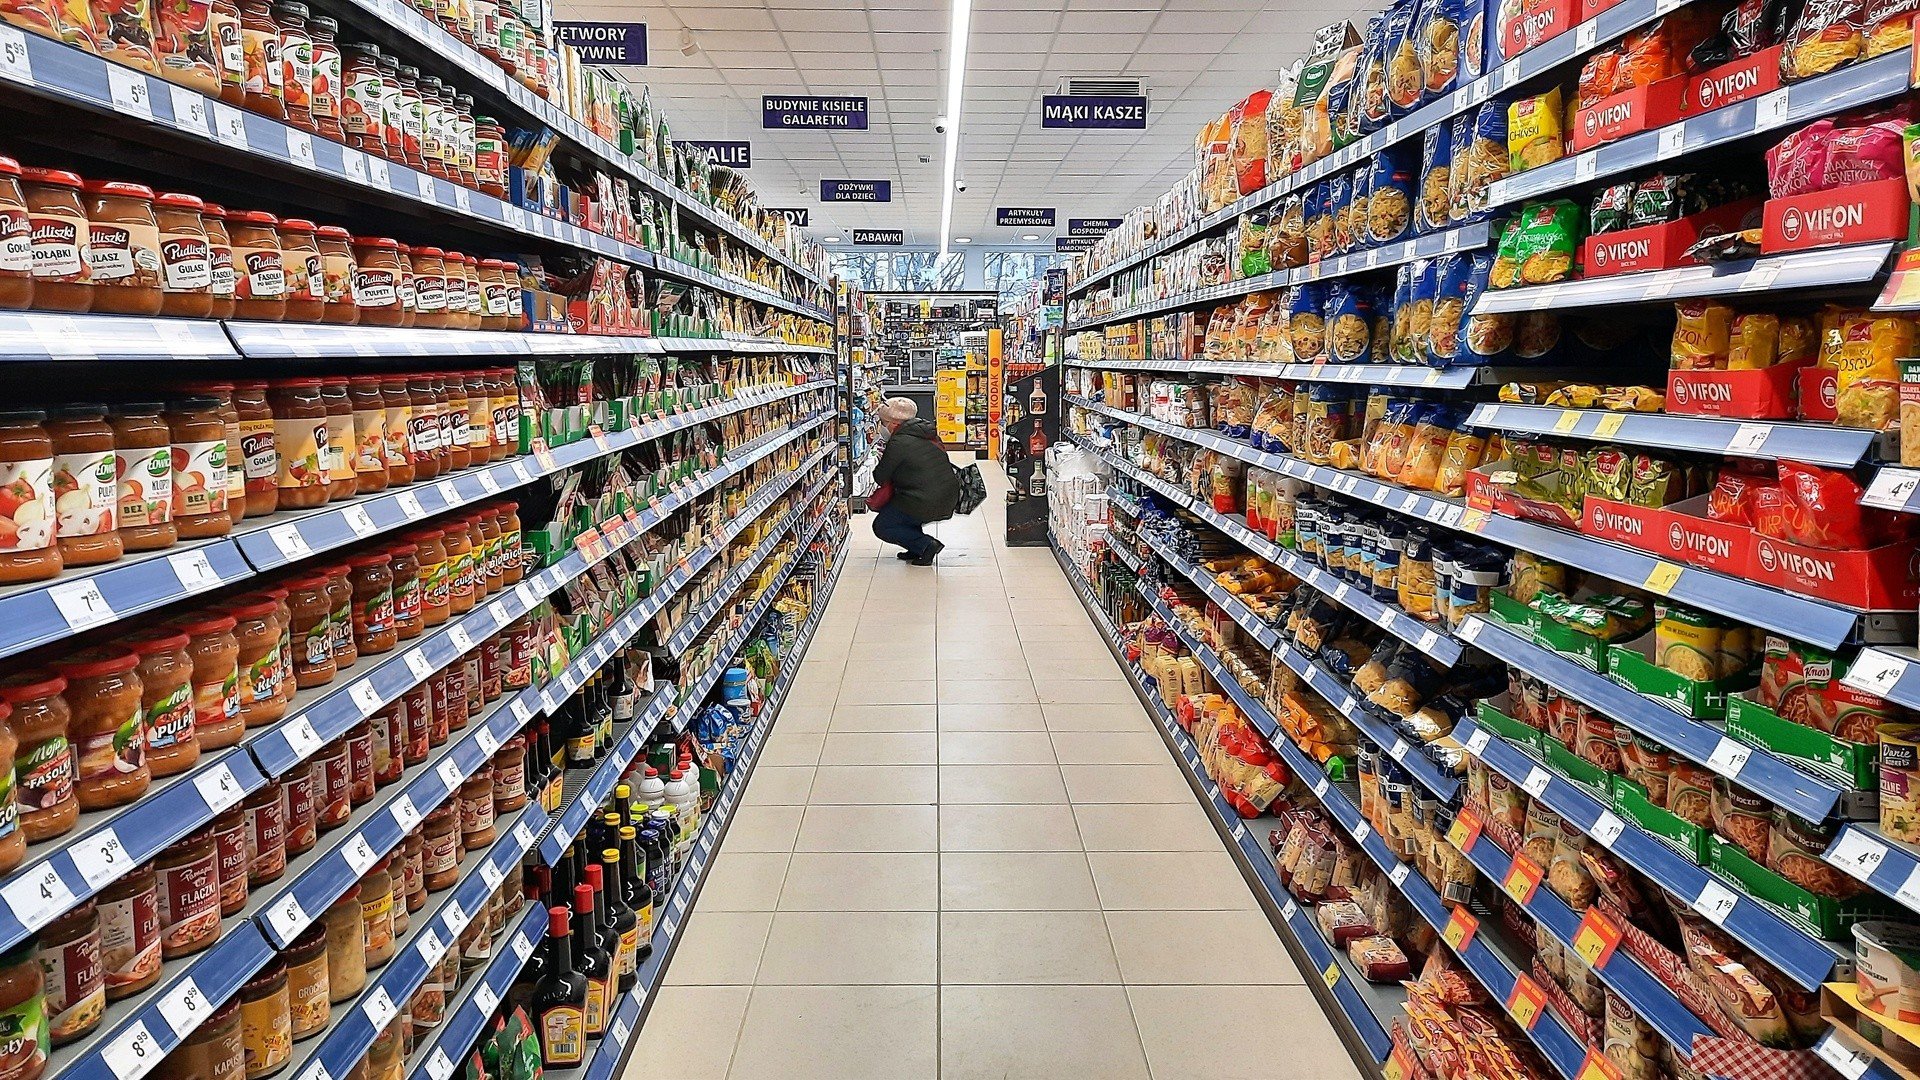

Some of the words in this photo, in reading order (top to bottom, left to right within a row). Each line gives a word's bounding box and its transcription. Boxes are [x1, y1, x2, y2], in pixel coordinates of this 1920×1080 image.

[573, 46, 626, 60] YWNE
[1715, 67, 1758, 97] VIFON
[766, 100, 819, 111] BUDYNIE
[822, 100, 864, 112] KISIELE
[1045, 105, 1089, 122] MĄKI
[1093, 106, 1143, 120] KASZE
[1598, 101, 1632, 127] VIFON
[782, 114, 848, 126] GALARETKI
[835, 192, 850, 200] DLA
[838, 183, 874, 191] ODŻYWKI
[1804, 202, 1863, 232] VIFON
[855, 232, 902, 243] ZABAWKI
[1607, 240, 1649, 261] VIFON
[178, 263, 205, 274] GULASZ
[364, 288, 389, 297] PULPETY
[990, 373, 999, 408] KODAK
[1687, 382, 1732, 402] VIFON
[1891, 480, 1915, 497] 449
[124, 504, 142, 514] BEZ
[187, 494, 205, 504] BEZ
[1605, 512, 1643, 535] VIFON
[1685, 530, 1731, 558] VIFON
[1777, 550, 1834, 581] VIFON
[81, 589, 100, 612] 799
[1804, 665, 1830, 679] Knorr
[1876, 668, 1900, 682] 449
[28, 737, 62, 765] Moja
[100, 838, 119, 864] 399
[1857, 851, 1881, 866] 449
[40, 872, 57, 900] 449
[181, 882, 216, 906] FLACZKI
[184, 986, 198, 1012] 899
[1608, 995, 1632, 1017] amino
[132, 1030, 148, 1058] 899
